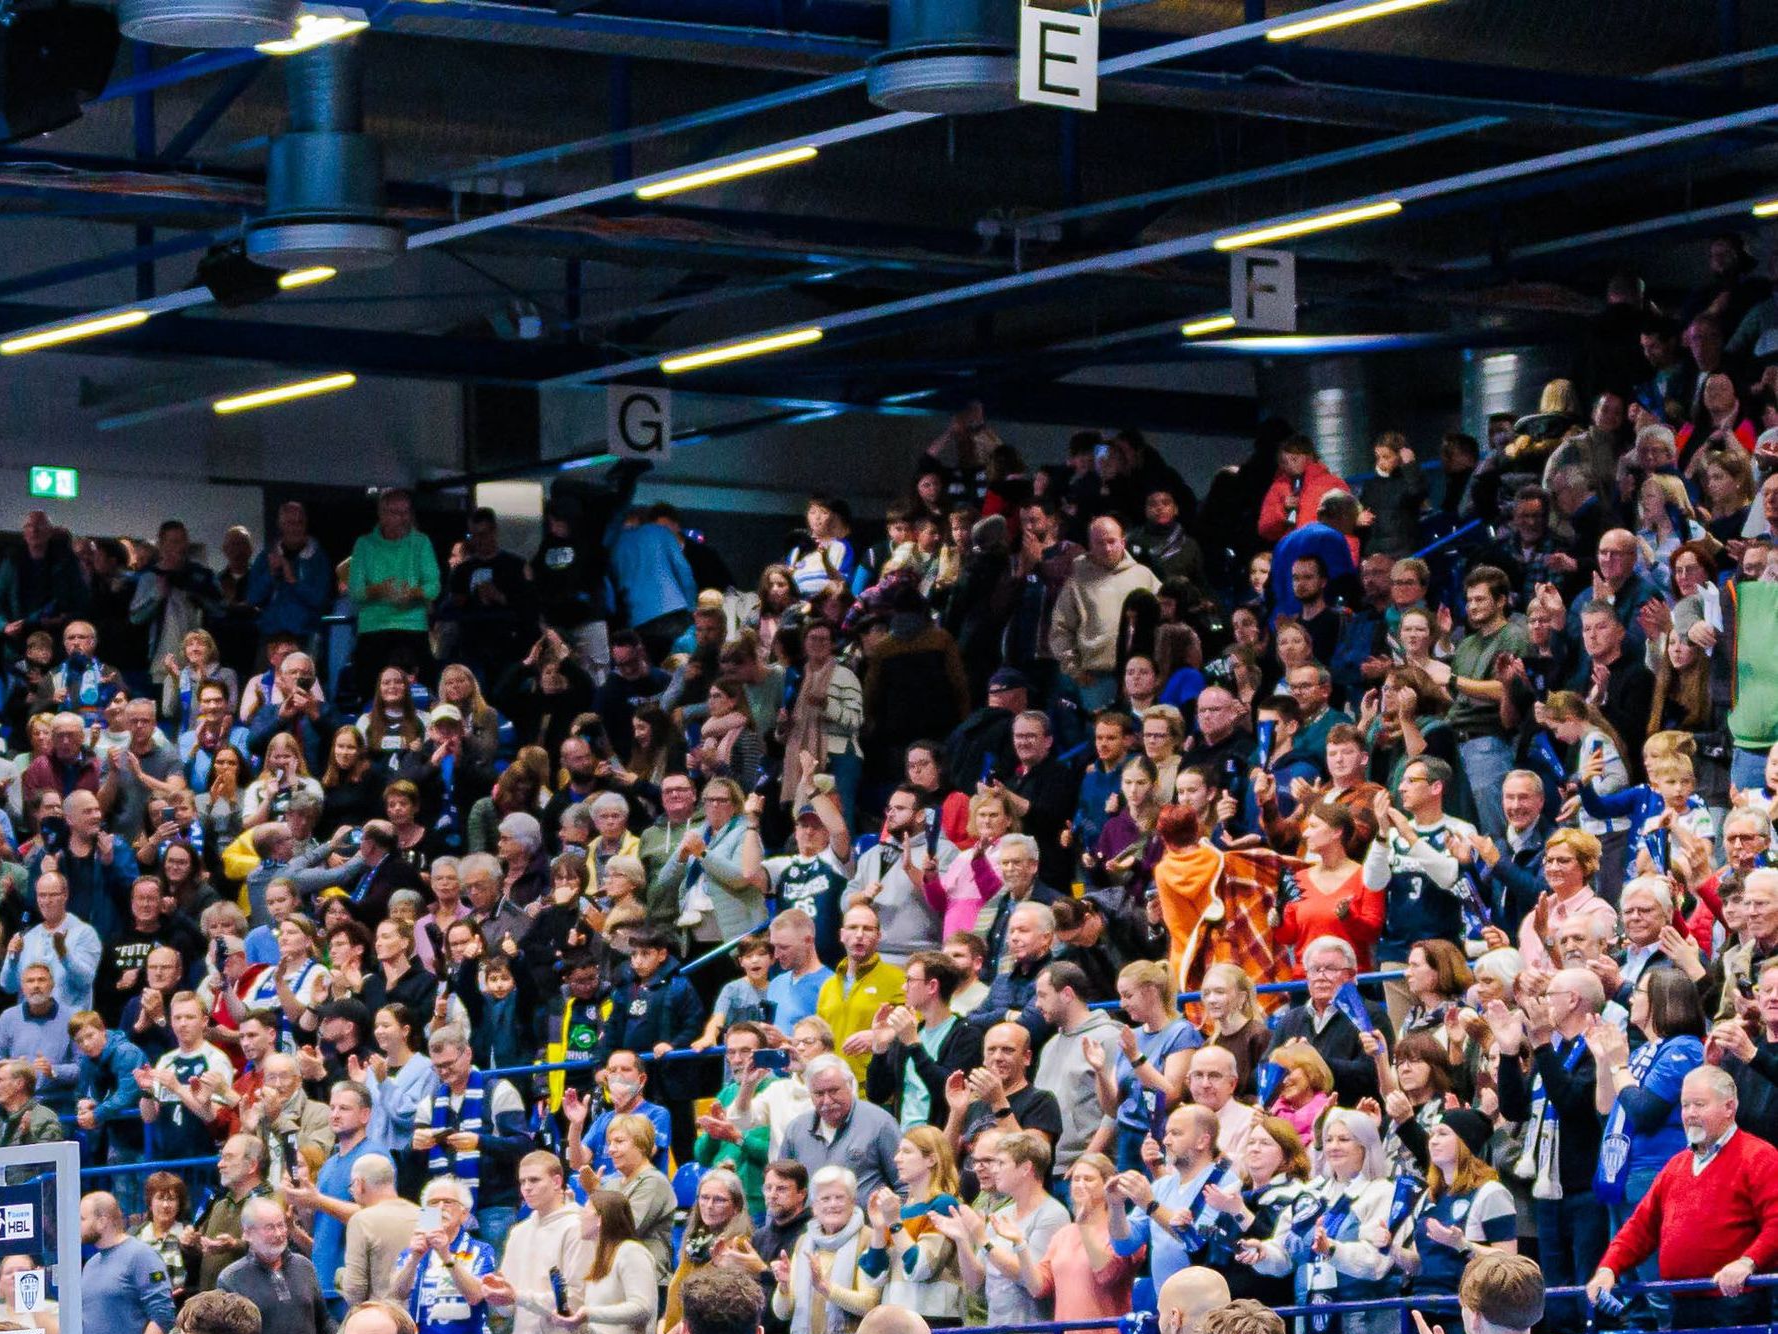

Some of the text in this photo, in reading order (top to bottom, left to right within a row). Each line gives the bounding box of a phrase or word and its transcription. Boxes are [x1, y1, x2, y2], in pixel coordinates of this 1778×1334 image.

[1038, 20, 1081, 97] E
[1245, 256, 1280, 319] F
[618, 393, 662, 452] G
